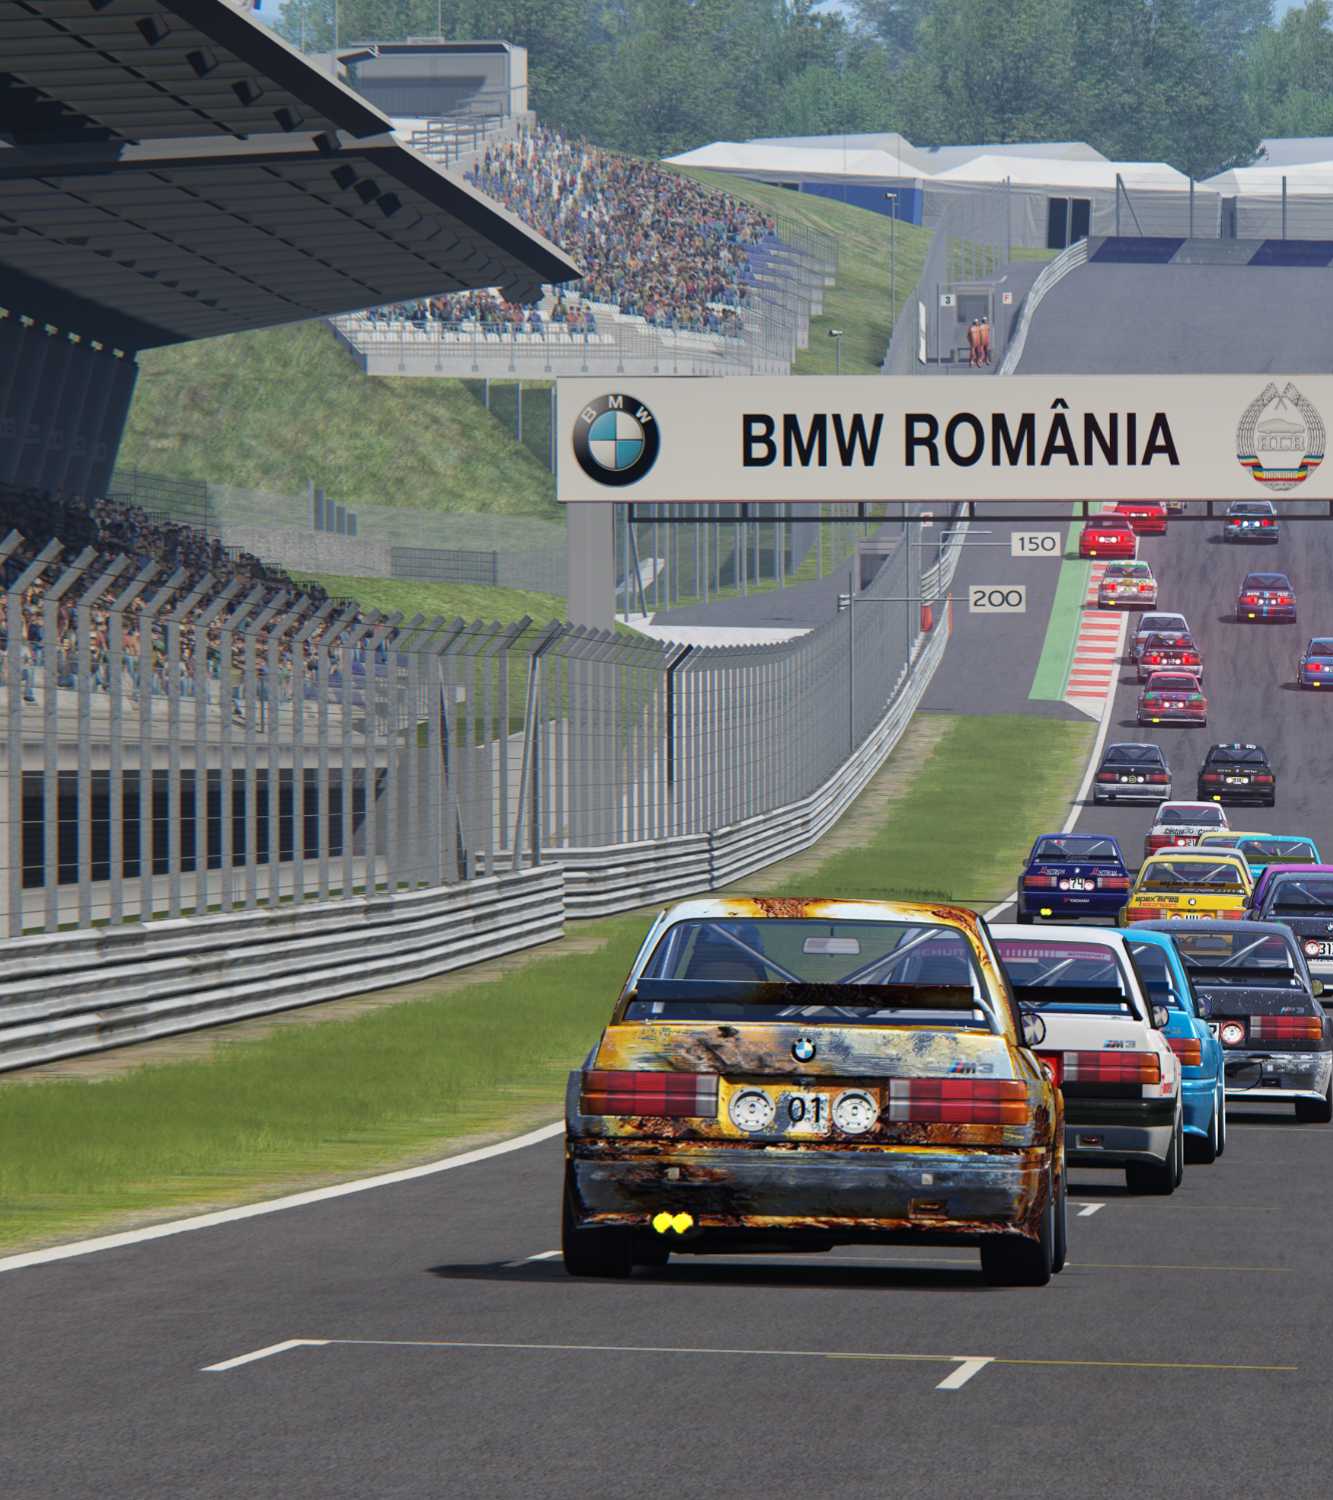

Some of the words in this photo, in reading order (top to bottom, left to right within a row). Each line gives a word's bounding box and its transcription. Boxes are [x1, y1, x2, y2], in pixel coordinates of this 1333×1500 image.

[581, 395, 652, 424] BMW
[743, 413, 883, 467] BMW
[905, 398, 1179, 467] ROMÂNIA
[1019, 536, 1056, 552] 150
[973, 590, 1023, 607] 200
[1071, 879, 1084, 889] 74
[788, 1096, 820, 1123] 01
